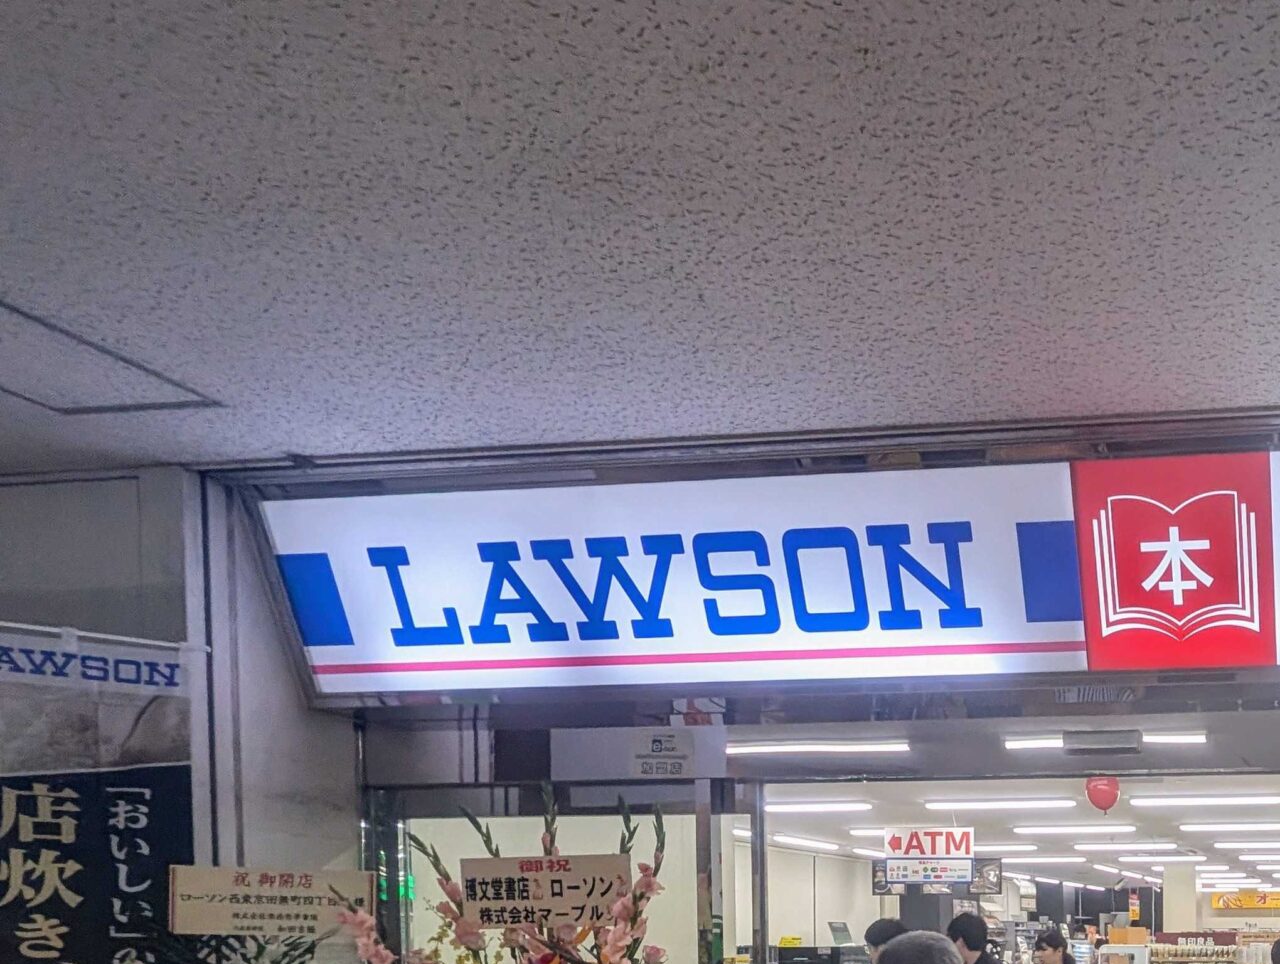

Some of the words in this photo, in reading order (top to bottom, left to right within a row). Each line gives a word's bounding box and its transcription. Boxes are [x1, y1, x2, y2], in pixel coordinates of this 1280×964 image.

[368, 521, 982, 646] LAWSON
[1139, 526, 1214, 605] 本
[518, 859, 572, 873] 御祝
[903, 831, 971, 855] ATM
